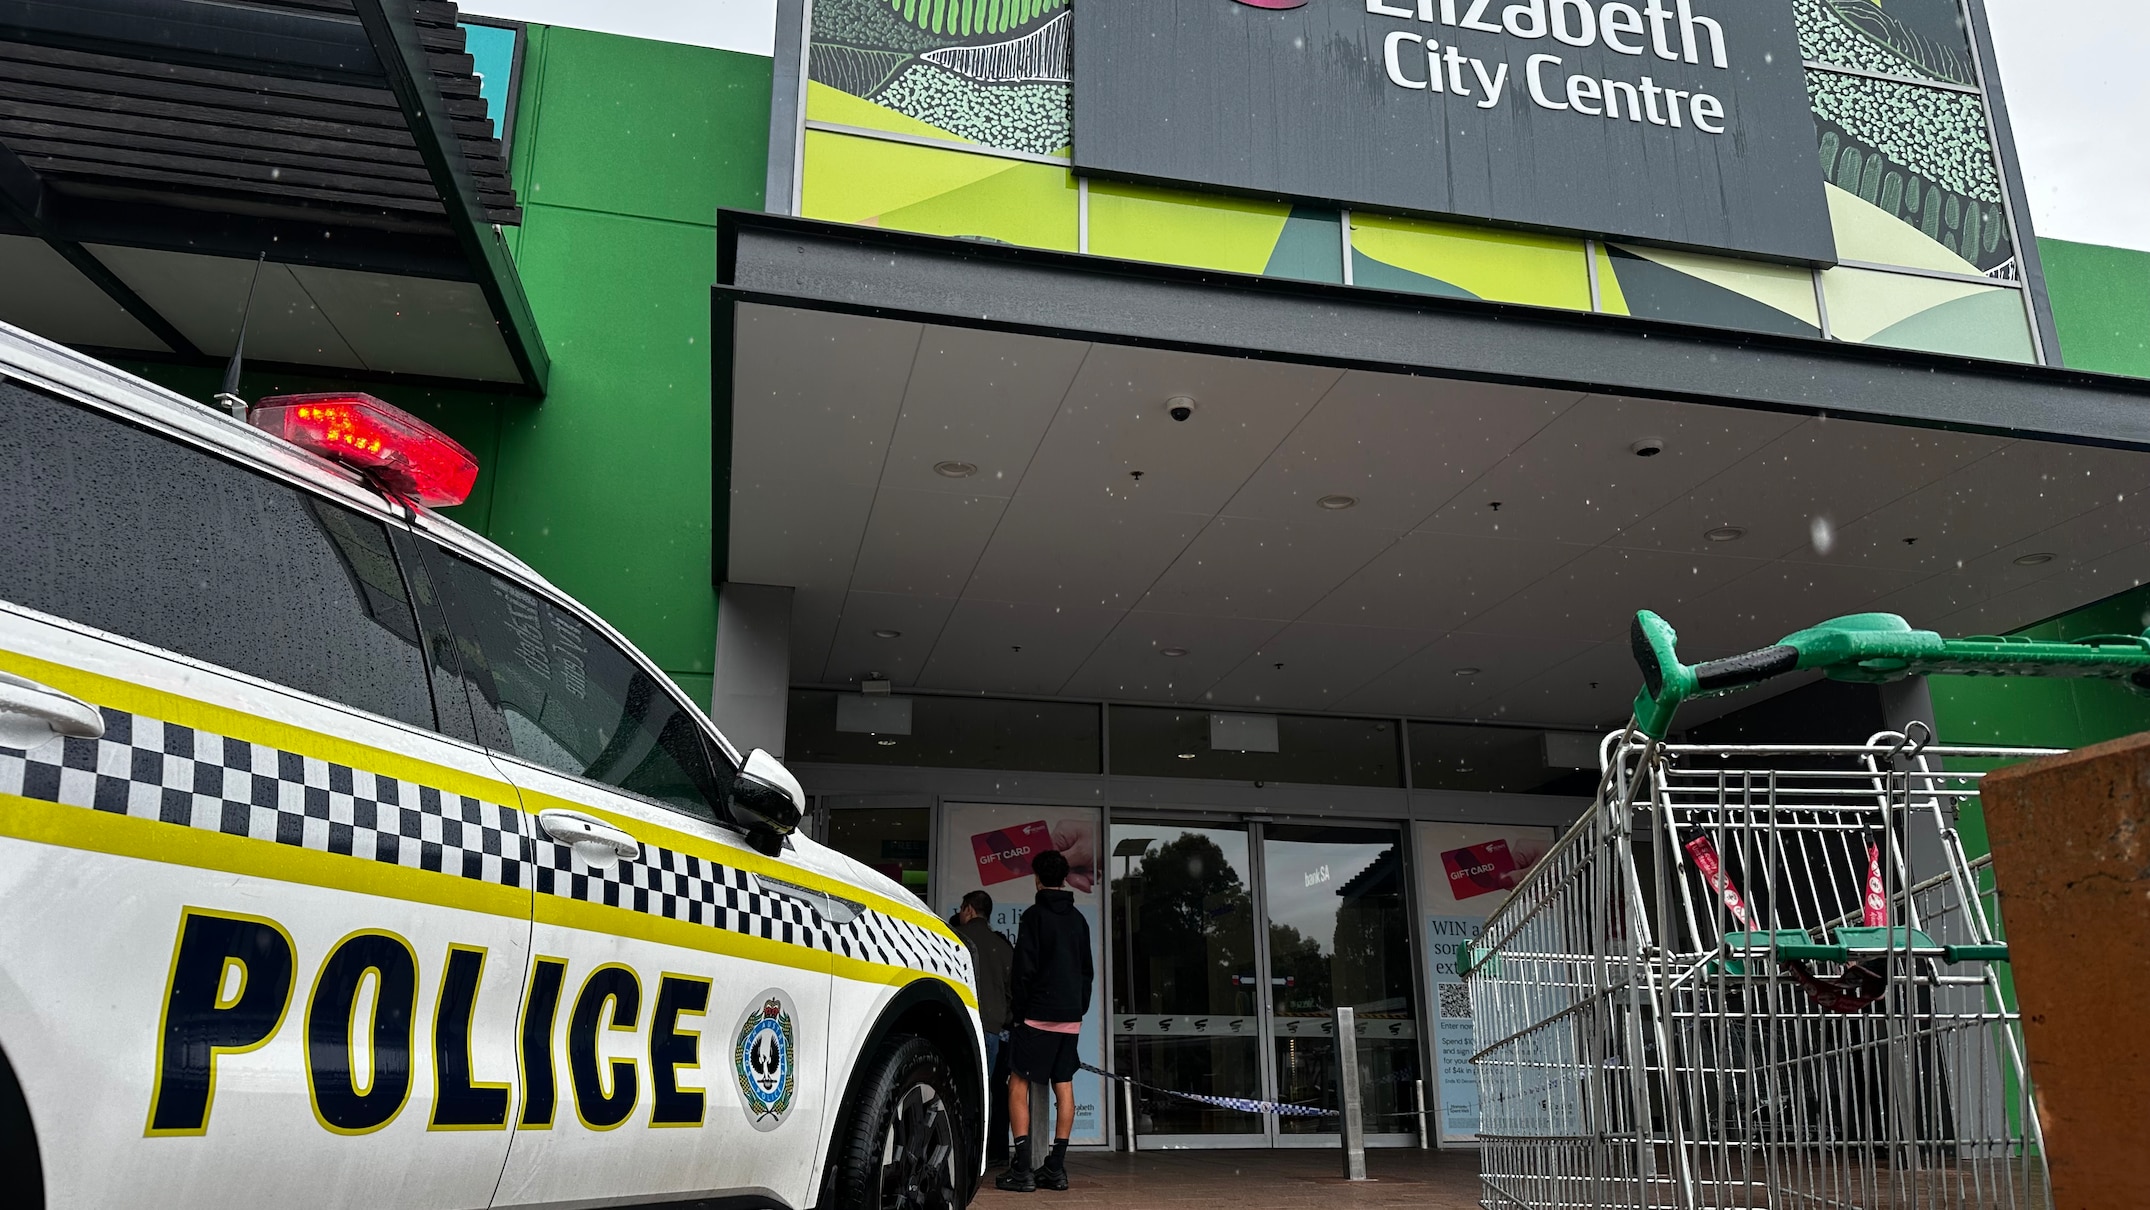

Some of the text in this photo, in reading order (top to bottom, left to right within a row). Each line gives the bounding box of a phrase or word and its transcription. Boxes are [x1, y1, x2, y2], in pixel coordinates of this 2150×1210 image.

[1366, 0, 1728, 69] zabeth
[1384, 31, 1725, 134] City Centre
[979, 846, 1031, 865] GIFT CARD
[1304, 864, 1341, 888] bankSA
[1450, 863, 1495, 880] GIFT CARD
[1432, 920, 1480, 937] WIN a
[143, 906, 714, 1137] POLICE
[1457, 1048, 1470, 1056] sign
[1453, 1066, 1464, 1074] $4k
